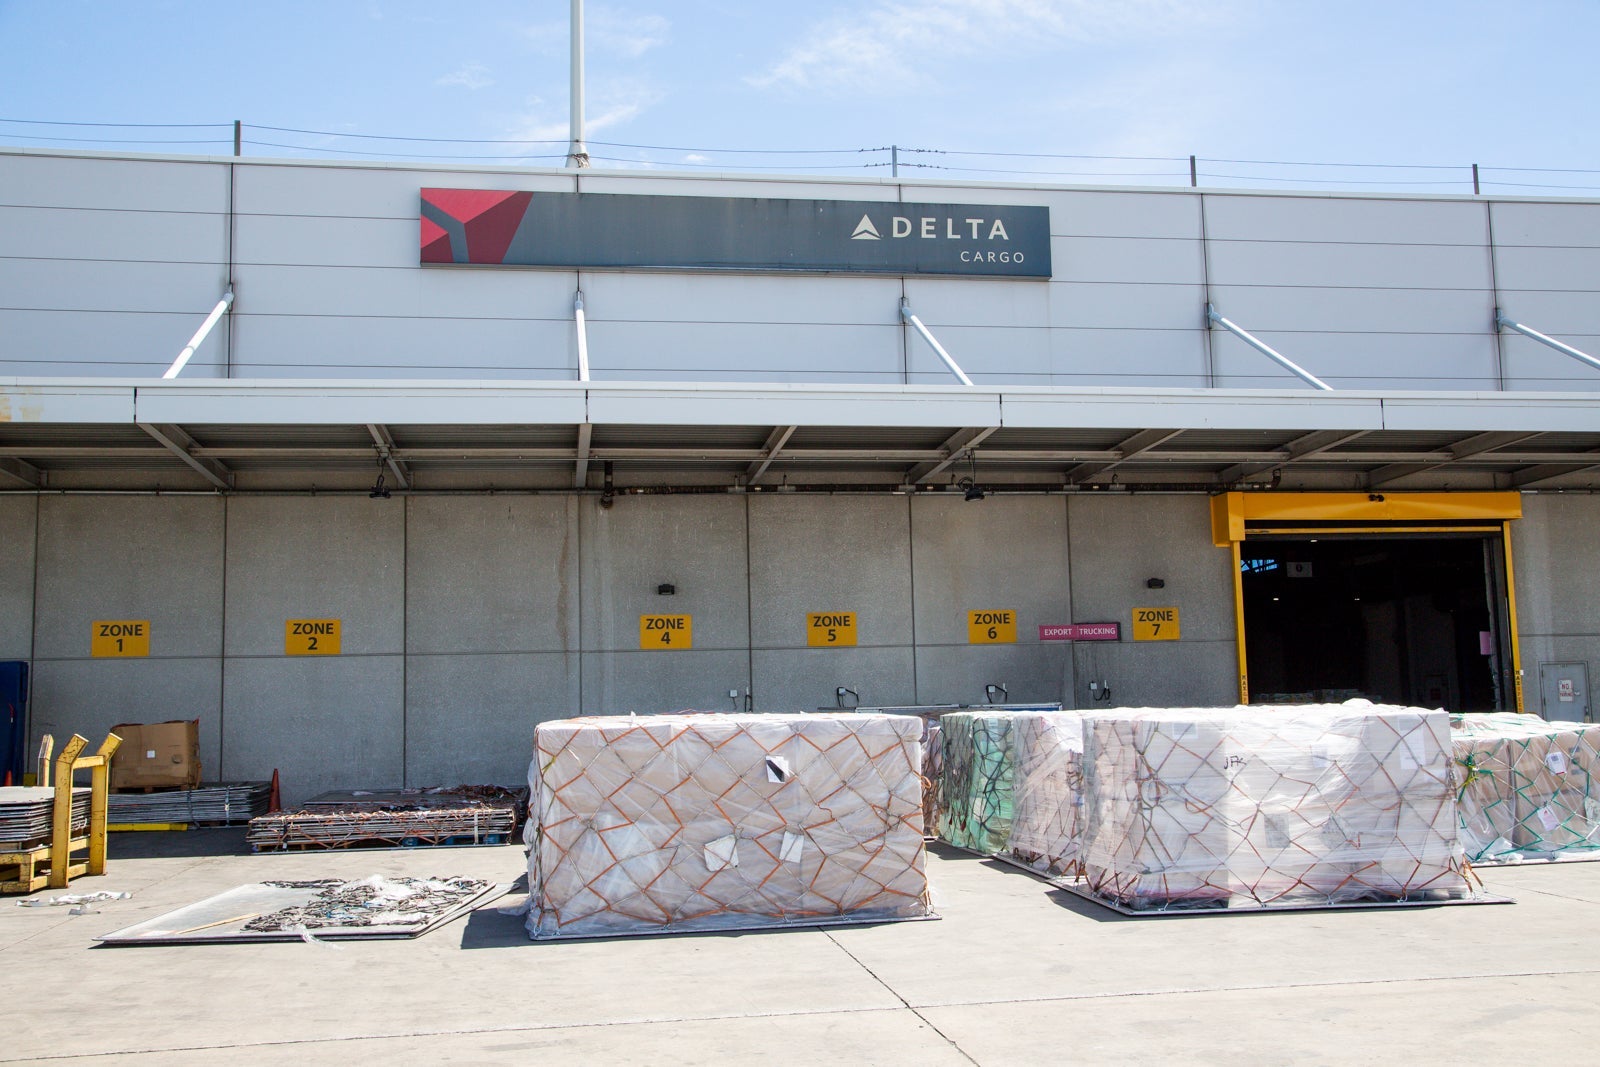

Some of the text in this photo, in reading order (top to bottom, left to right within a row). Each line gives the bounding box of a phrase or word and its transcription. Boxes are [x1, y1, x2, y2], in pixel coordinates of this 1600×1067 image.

[892, 216, 1010, 241] DELTA
[960, 251, 1025, 264] CARGO
[812, 615, 851, 627] ZONE
[973, 612, 1011, 625] ZONE
[1138, 610, 1174, 622] ZONE
[292, 622, 335, 635] ZONE
[645, 617, 685, 630] ZONE
[1151, 623, 1161, 636] 7
[99, 624, 144, 637] ZONE
[827, 628, 837, 642] 5
[987, 626, 998, 640] 6
[1044, 627, 1116, 636] EXPORT TRUCKING
[307, 636, 318, 650] 2
[660, 631, 672, 645] 4
[116, 638, 124, 652] 1
